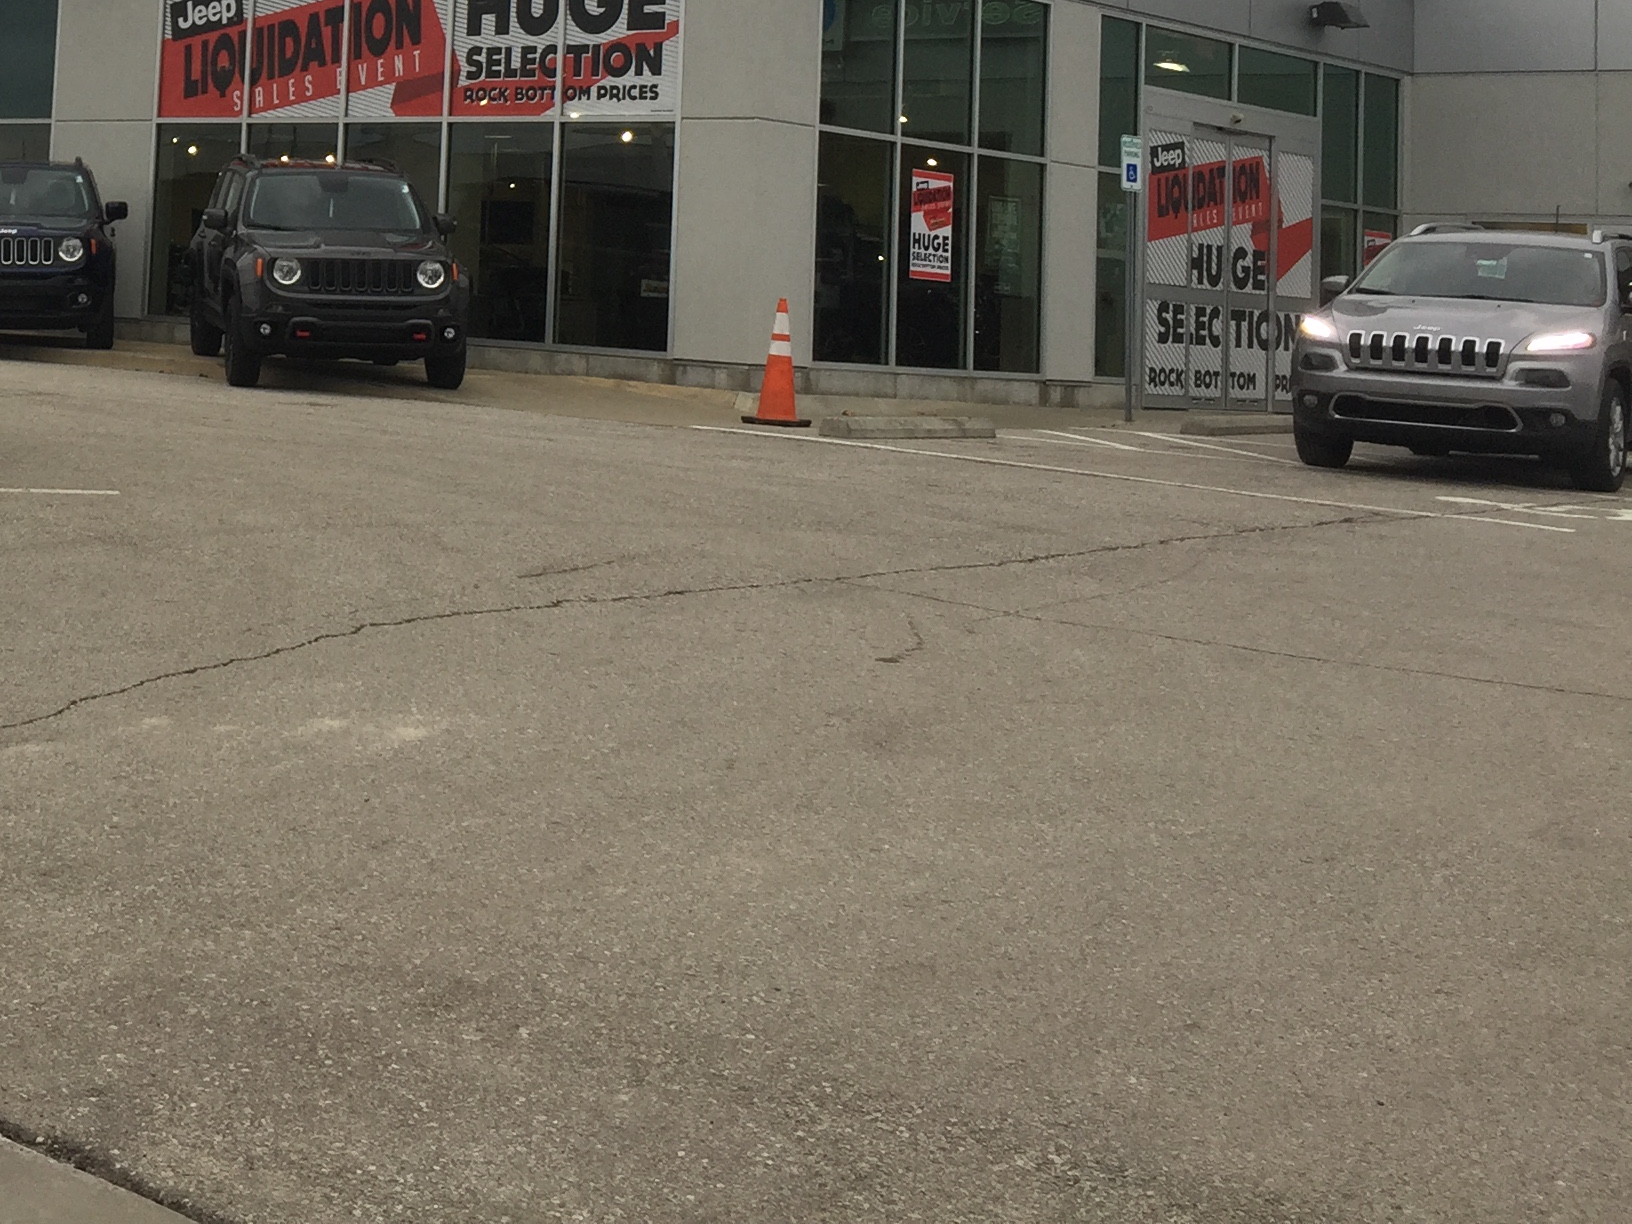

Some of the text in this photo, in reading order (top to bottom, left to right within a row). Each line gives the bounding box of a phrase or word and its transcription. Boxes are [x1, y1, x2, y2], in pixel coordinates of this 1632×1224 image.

[336, 49, 422, 89] EVENT
[465, 41, 663, 81] SELECTION
[232, 74, 314, 112] SALES
[463, 85, 509, 105] ROCK
[596, 83, 660, 103] PRICES
[1153, 147, 1183, 168] Jeep
[1157, 160, 1261, 220] LIQUIDATION
[1192, 208, 1218, 228] ALES
[912, 231, 950, 254] HUGE
[1191, 242, 1266, 291] HUGE
[1157, 300, 1301, 352] SEECTION
[1148, 366, 1185, 389] ROCK
